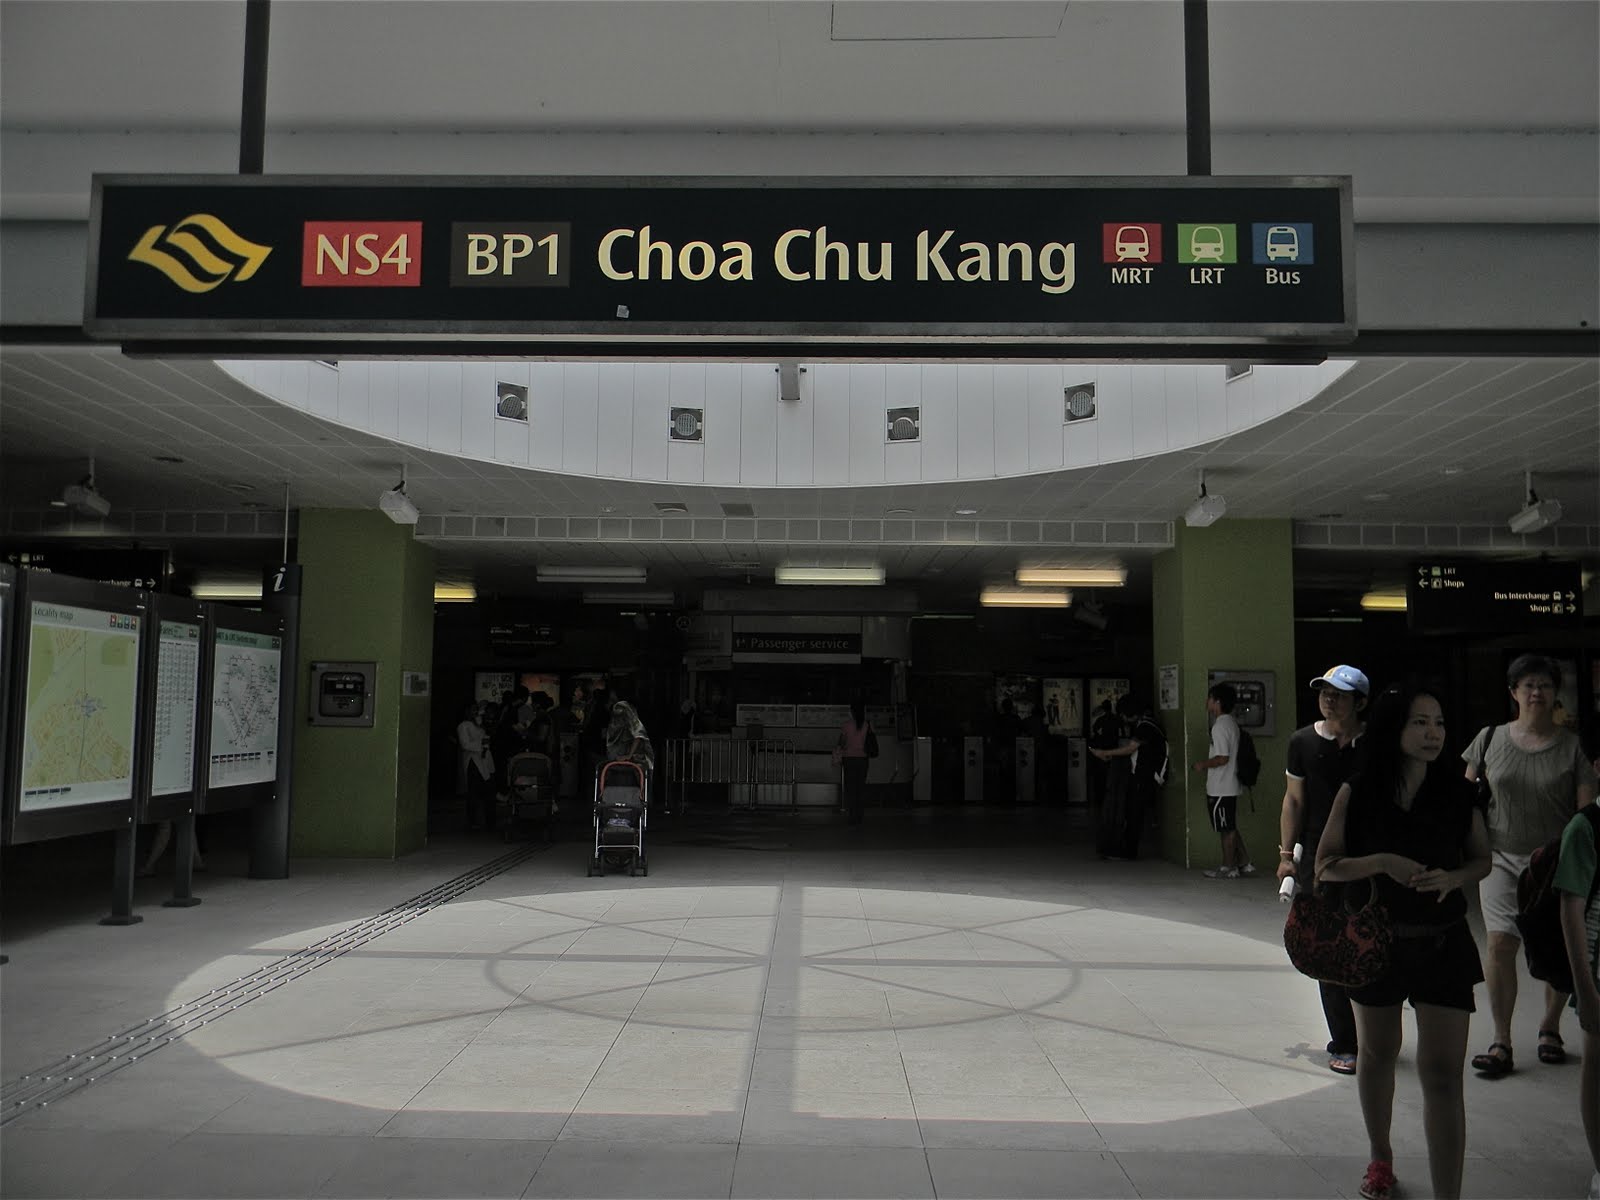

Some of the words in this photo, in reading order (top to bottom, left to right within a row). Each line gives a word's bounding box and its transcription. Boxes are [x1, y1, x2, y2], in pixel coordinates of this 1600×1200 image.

[315, 232, 412, 276] NS4
[466, 232, 560, 276] BP1
[597, 225, 754, 281] Choa
[773, 225, 893, 282] Chu
[916, 229, 1076, 295] Kang
[1111, 267, 1154, 284] MRT
[1190, 267, 1225, 284] LRT
[1265, 267, 1300, 285] Bus
[1443, 580, 1464, 588] Shops
[1494, 591, 1507, 600] Bus
[1509, 591, 1550, 601] Interchange
[34, 607, 58, 619] Locality
[60, 610, 74, 620] map
[1529, 604, 1551, 613] Shops
[751, 637, 809, 651] Passenger
[810, 637, 849, 649] service
